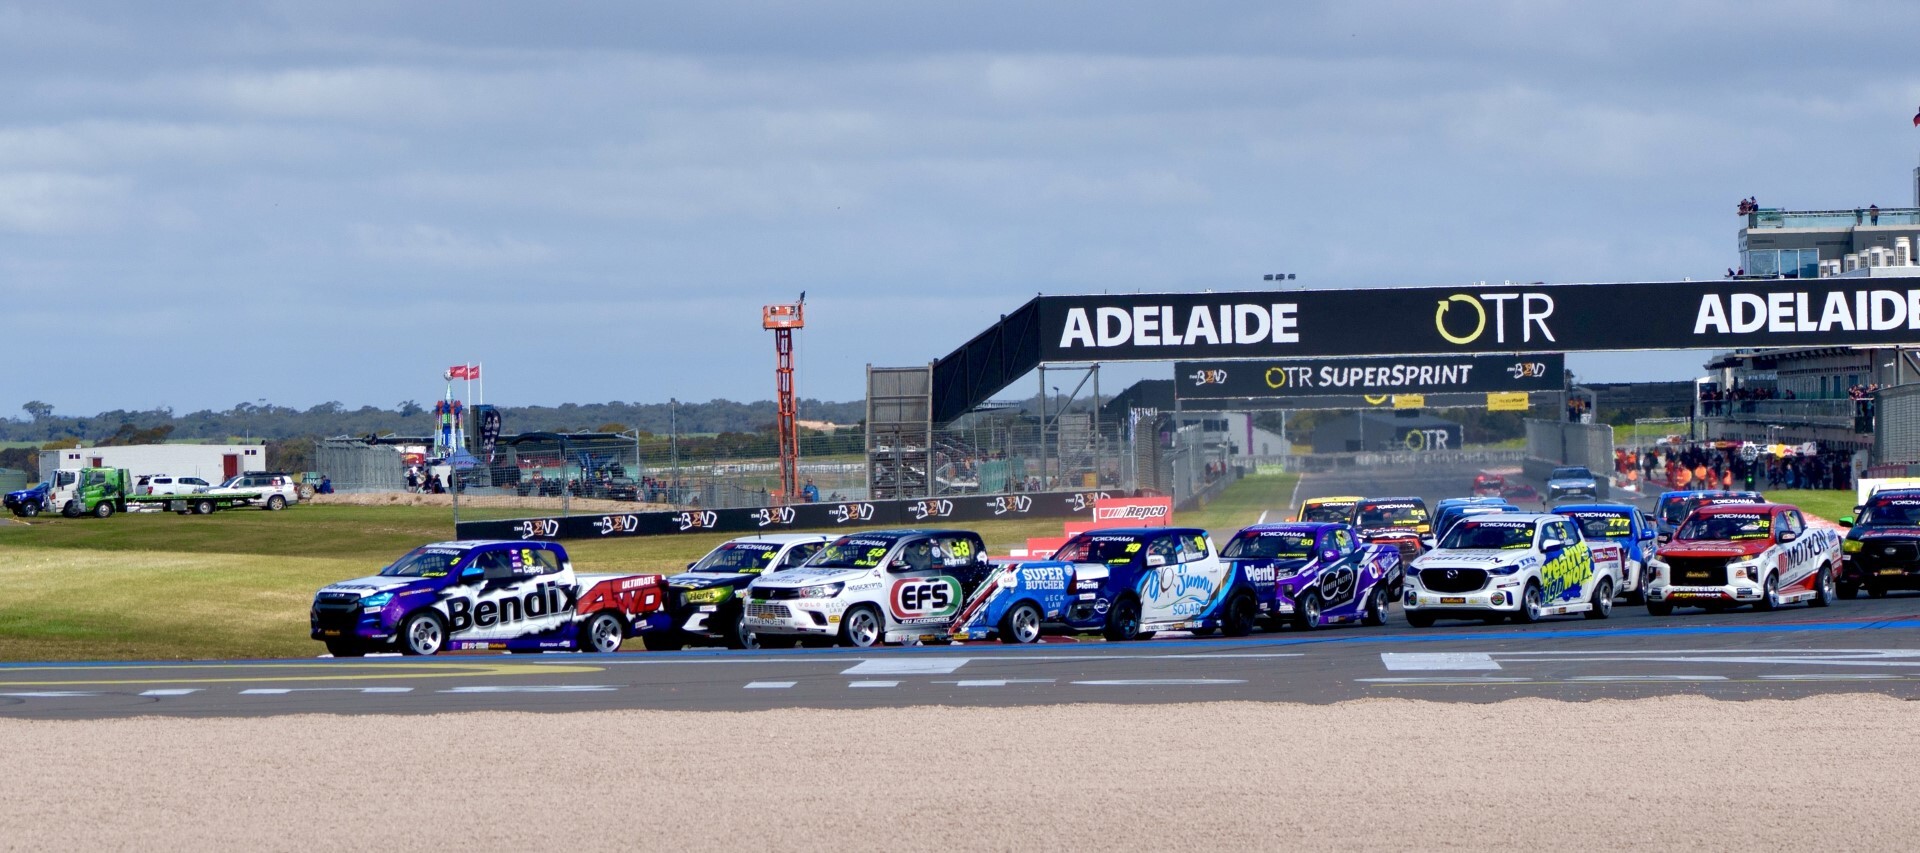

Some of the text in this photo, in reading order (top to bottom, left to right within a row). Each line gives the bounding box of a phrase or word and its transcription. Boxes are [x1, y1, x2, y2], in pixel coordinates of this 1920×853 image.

[1059, 303, 1299, 348] ADELAIDE
[1435, 293, 1556, 345] OTR
[1265, 364, 1473, 388] OTR SUPERSPRINT
[1405, 429, 1448, 451] OTR
[1126, 505, 1167, 519] Repco
[1608, 518, 1631, 527] 777
[1125, 543, 1141, 552] 19
[1300, 538, 1314, 546] 50
[521, 549, 533, 565] 5
[867, 548, 887, 557] 58
[943, 557, 967, 566] Harris
[523, 565, 544, 574] Casey
[1022, 567, 1065, 581] SUPER
[1244, 563, 1275, 581] Plenti
[622, 576, 656, 589] ULTIMATE
[1025, 581, 1065, 590] BUTCHER
[690, 591, 716, 601] Hertz
[901, 584, 948, 610] EFS
[446, 580, 581, 633] Bendix
